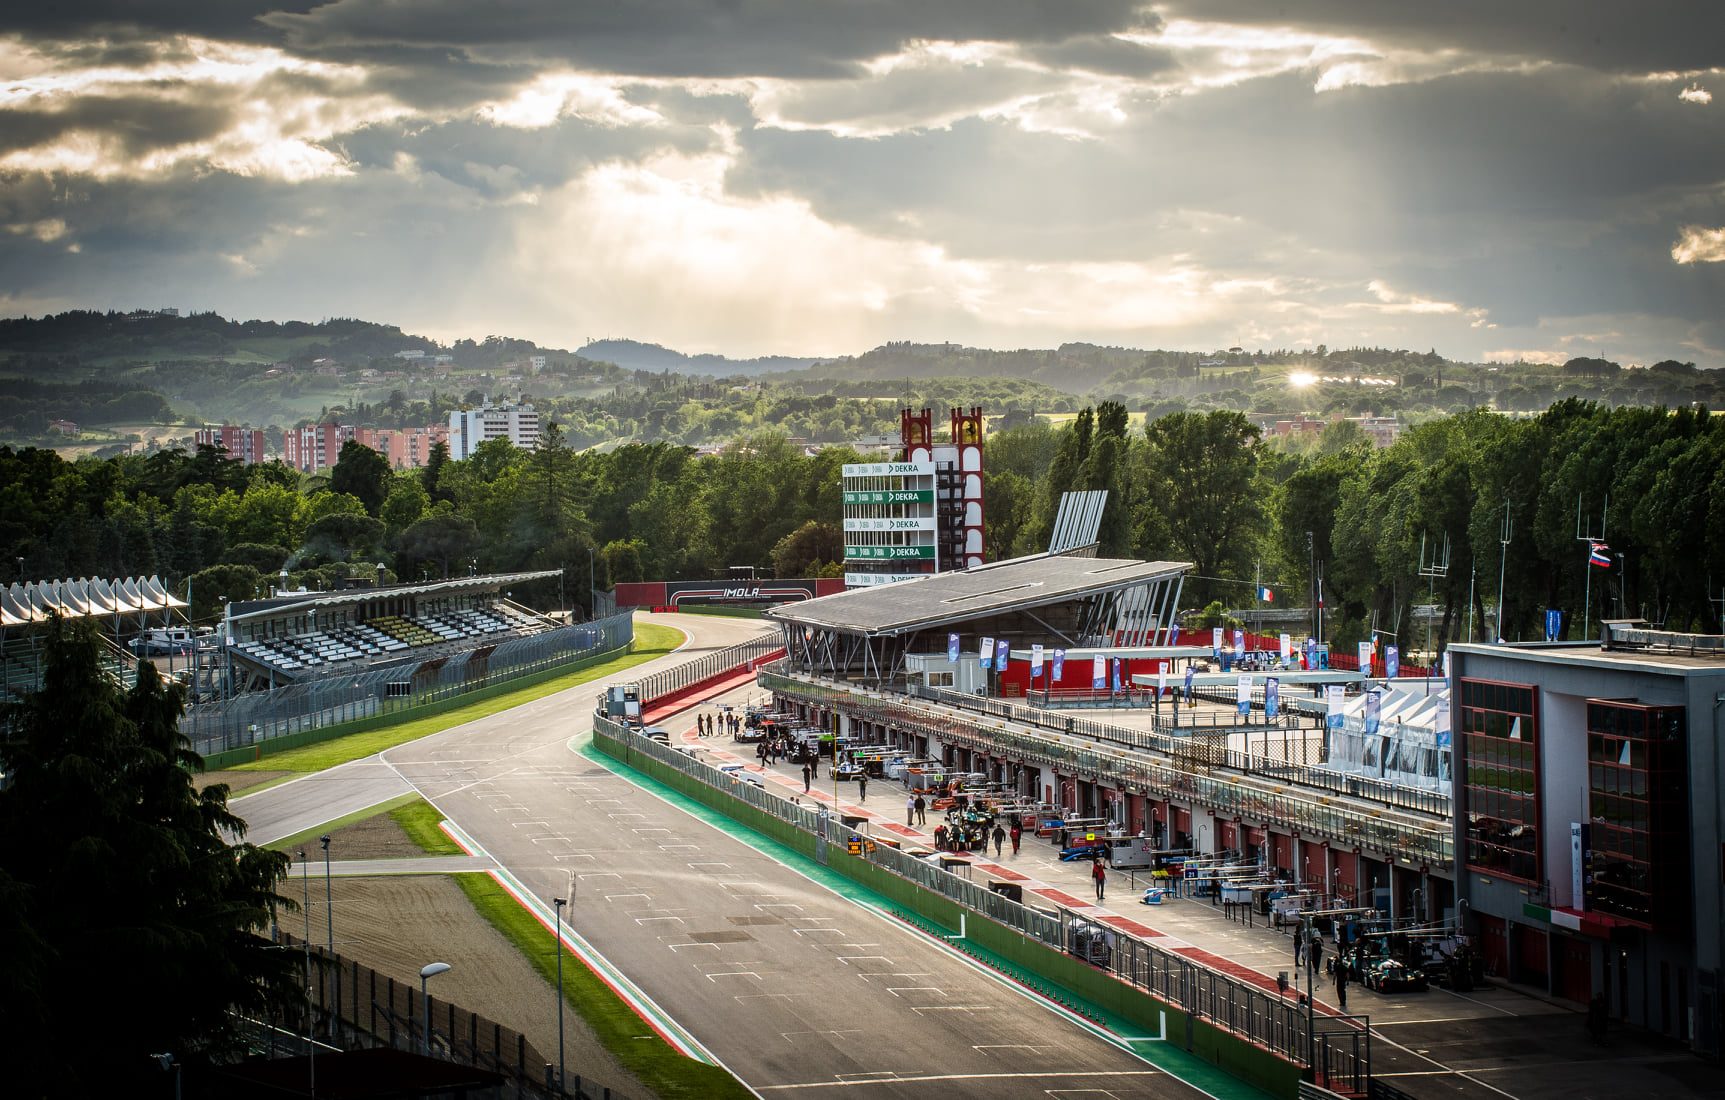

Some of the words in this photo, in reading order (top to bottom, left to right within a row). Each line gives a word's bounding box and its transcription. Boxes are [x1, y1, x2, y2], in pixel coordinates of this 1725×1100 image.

[895, 464, 918, 472] DEKRA
[895, 492, 919, 501] DEKRA
[896, 520, 919, 528] DEKRA
[896, 548, 920, 556] DEKRA
[723, 587, 760, 597] IMOLA
[1245, 651, 1275, 662] ELMS
